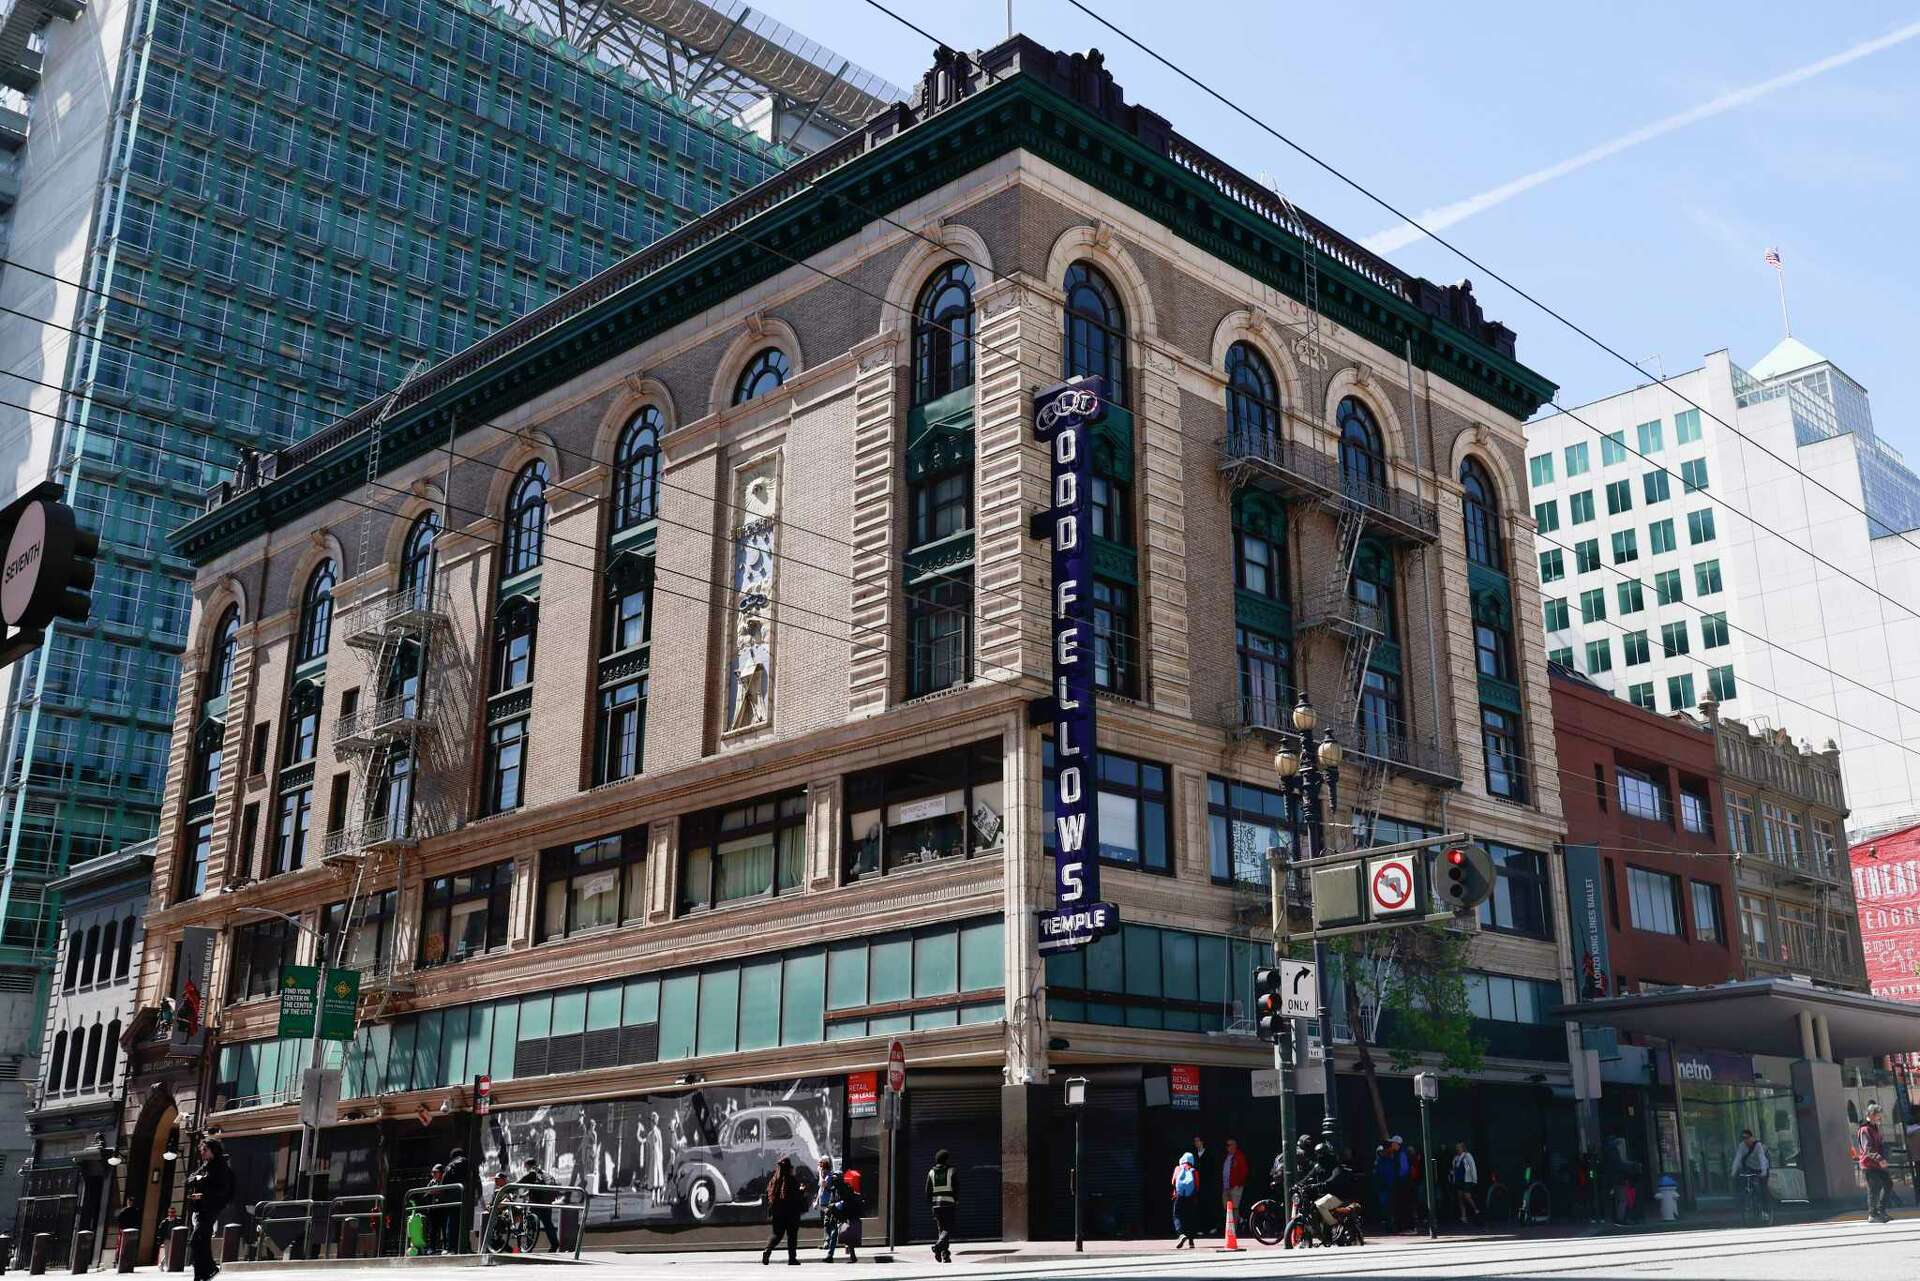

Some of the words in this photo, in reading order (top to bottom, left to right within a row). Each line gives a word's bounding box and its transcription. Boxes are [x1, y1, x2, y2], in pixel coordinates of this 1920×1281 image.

[1056, 429, 1077, 552] ODD
[5, 540, 41, 584] SEVENTH
[1057, 579, 1086, 901] FELLOWS
[1585, 879, 1596, 908] BALLET
[1041, 909, 1106, 936] TEMPLE
[205, 937, 214, 961] BALLET
[1288, 1000, 1309, 1011] ONLY
